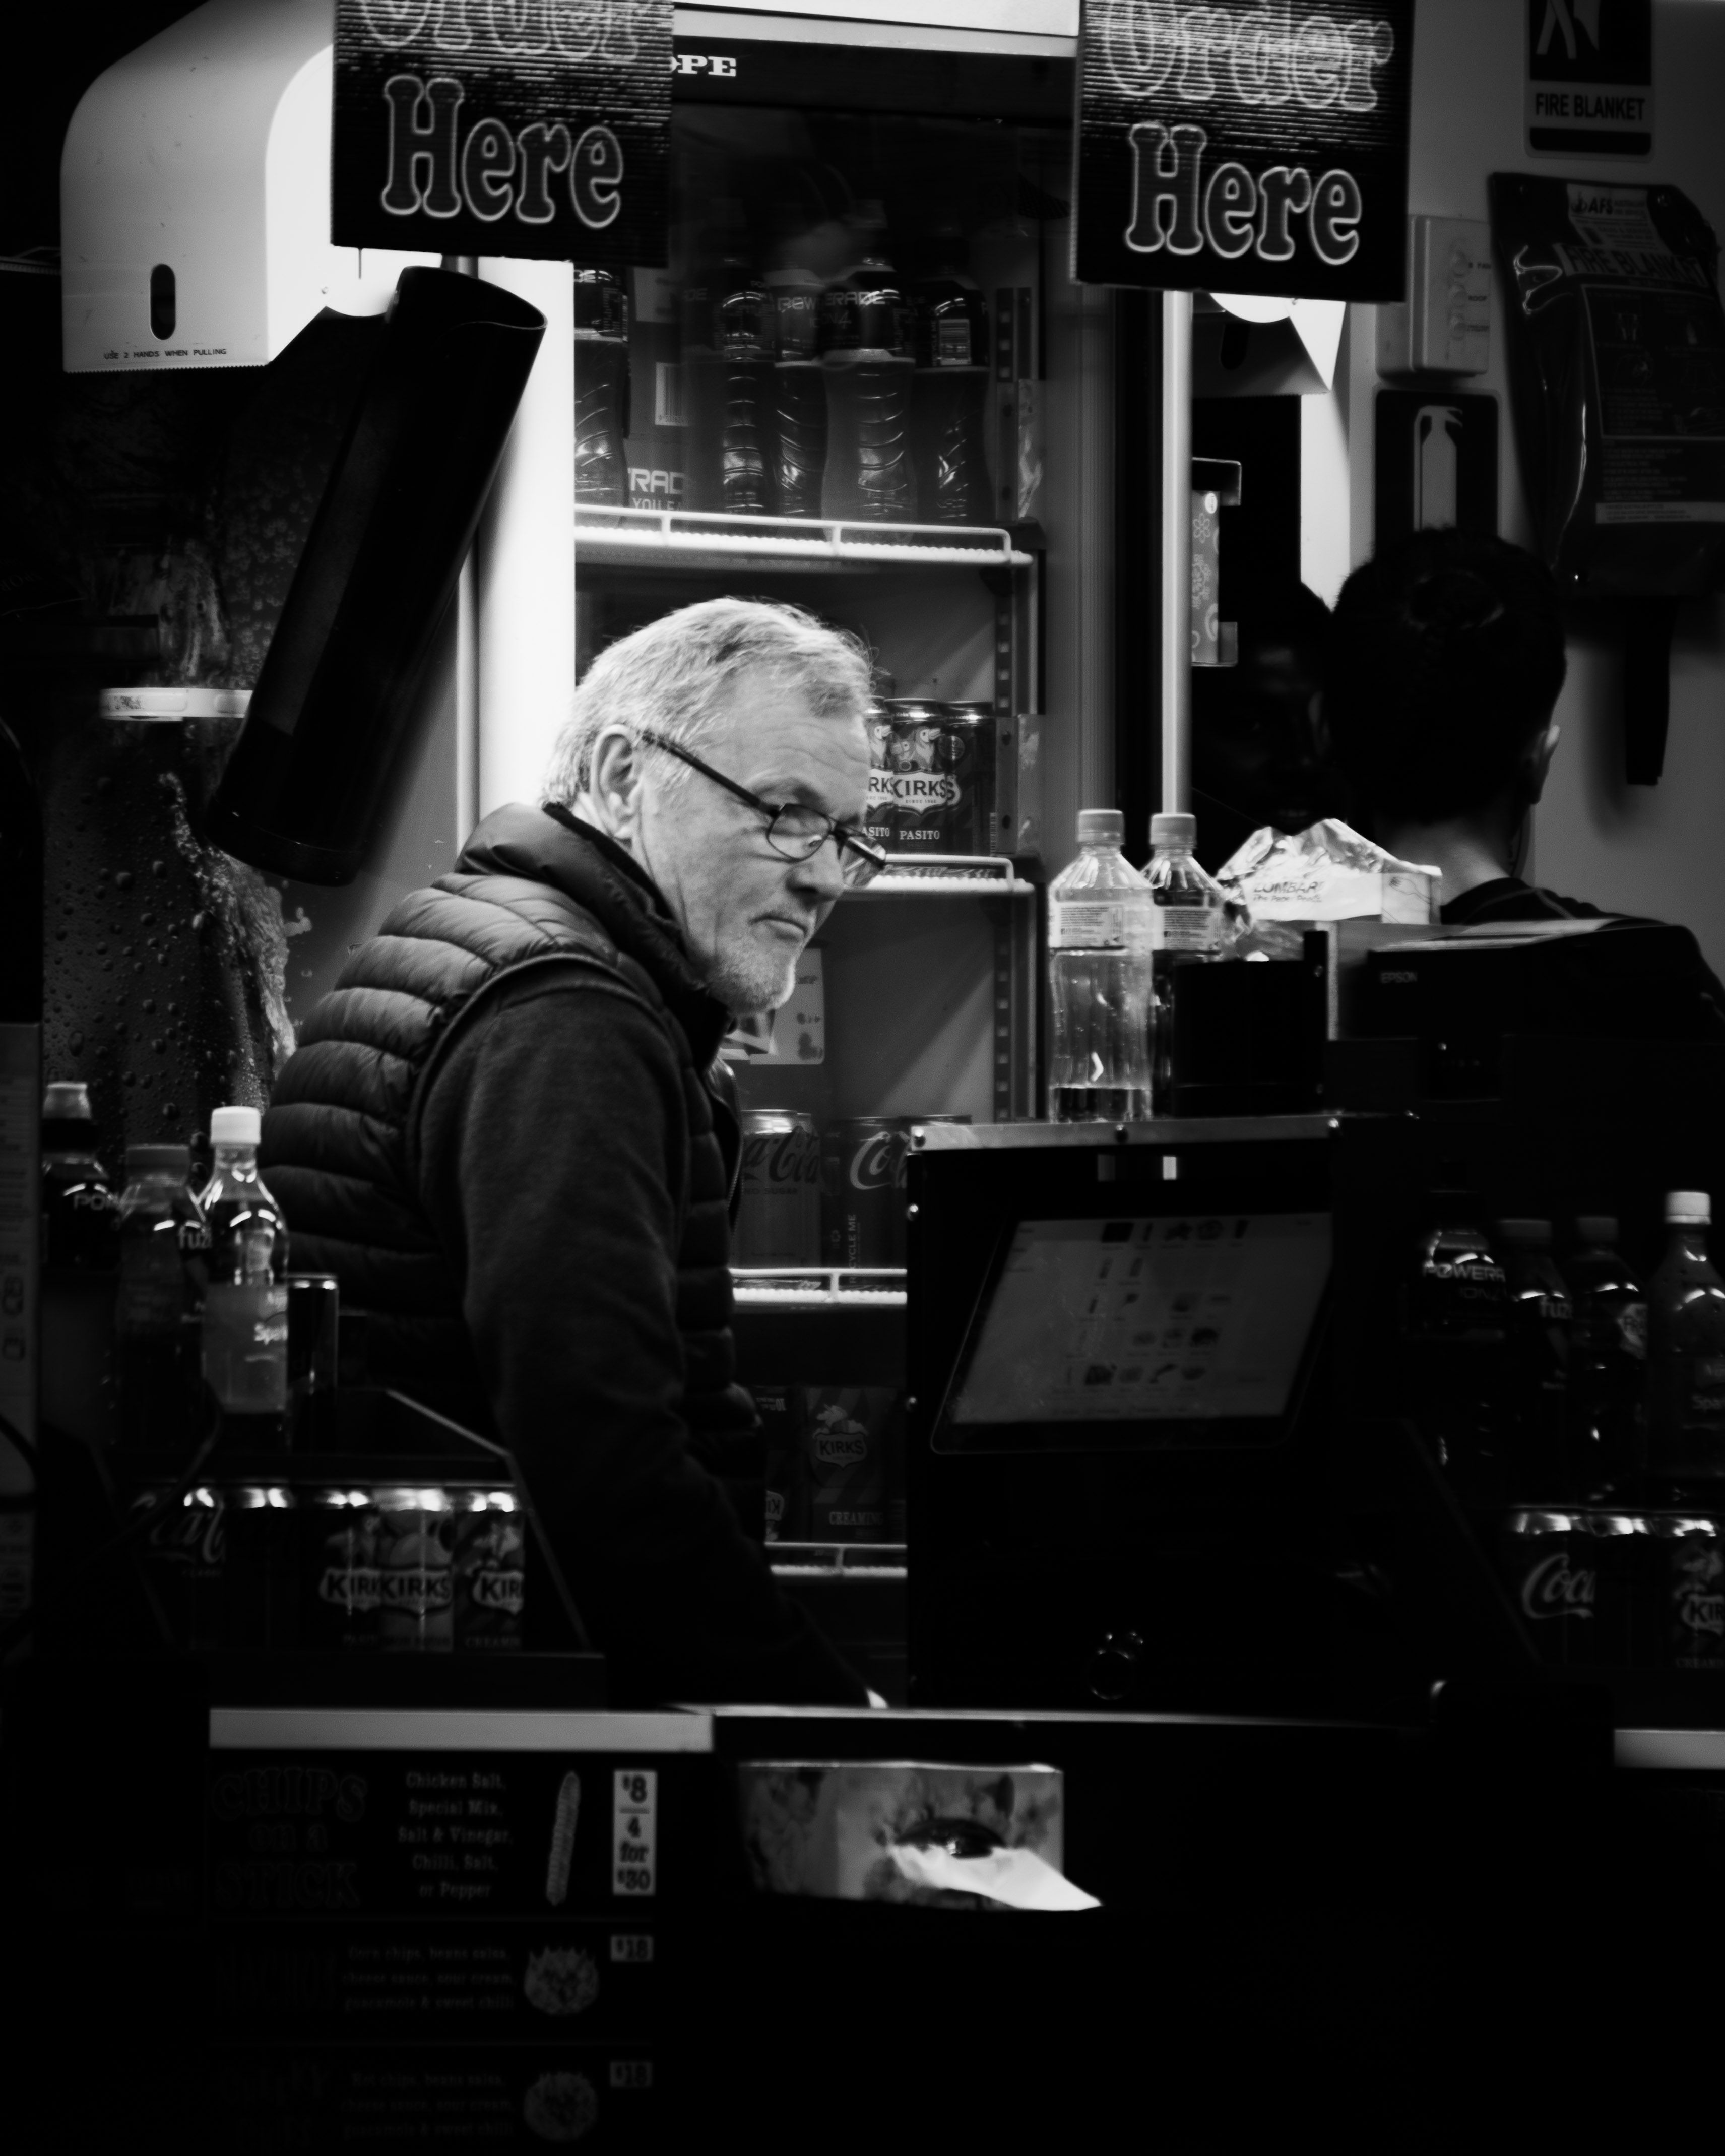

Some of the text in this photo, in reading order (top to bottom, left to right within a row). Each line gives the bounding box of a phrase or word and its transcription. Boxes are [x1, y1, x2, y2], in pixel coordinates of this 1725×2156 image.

[1536, 93, 1645, 120] FIRE BLANKET
[379, 73, 625, 230] Here
[1123, 119, 1364, 267] Here
[1588, 198, 1613, 214] AFS
[1562, 246, 1619, 274] FIRE
[899, 830, 941, 841] PASITO
[1380, 970, 1418, 984] EPSON
[848, 1214, 857, 1231] ME
[819, 1440, 863, 1455] KIRKS
[382, 1575, 449, 1599] KIRKS
[405, 1770, 507, 1792] Chicken Salt,
[210, 1765, 369, 1823] CHIPS
[408, 1798, 504, 1820] Special Mix,
[398, 1824, 515, 1848] Salt & Vinegar,
[627, 1816, 641, 1838] 4
[620, 1840, 650, 1862] for
[463, 1852, 499, 1874] Salt,
[214, 1860, 362, 1910] STICK
[419, 1880, 492, 1902] or Pepper
